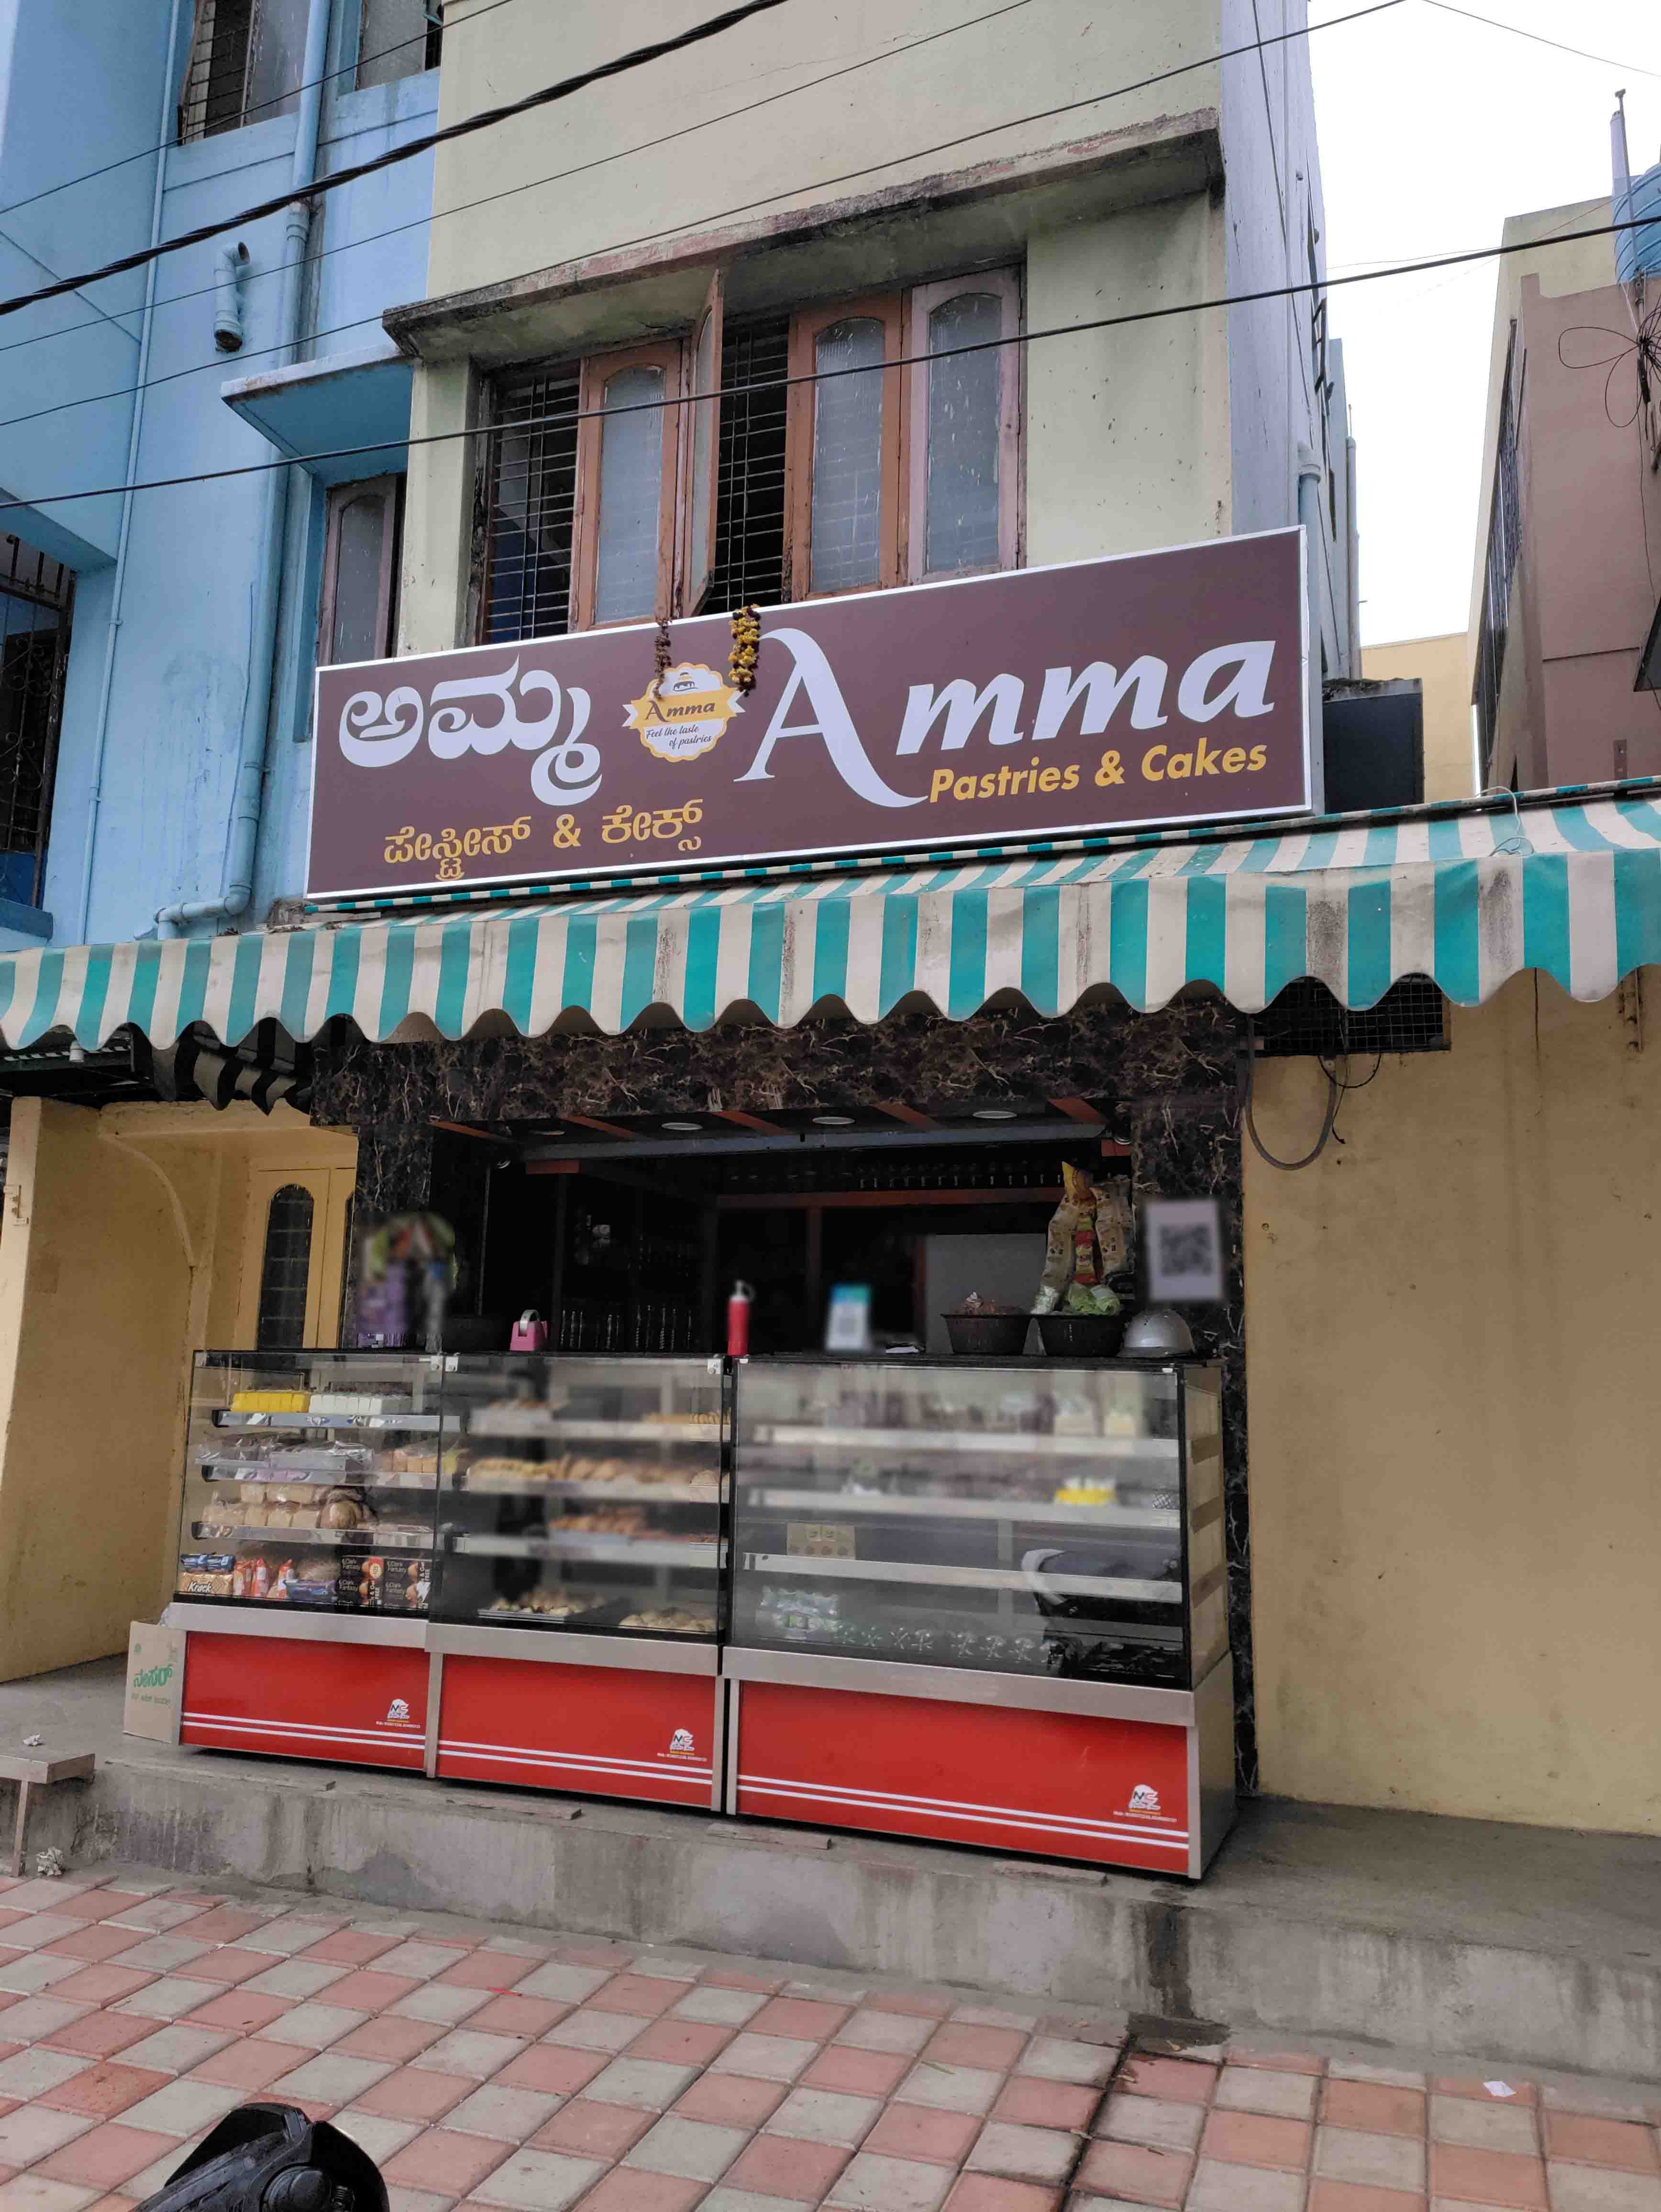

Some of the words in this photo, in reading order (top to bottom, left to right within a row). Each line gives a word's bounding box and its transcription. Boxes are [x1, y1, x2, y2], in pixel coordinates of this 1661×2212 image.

[339, 653, 602, 806] ಅಮ್ಮ
[644, 700, 716, 722] Amma
[647, 727, 663, 739] Feel
[664, 727, 677, 736] the
[679, 724, 699, 735] taste
[669, 738, 678, 750] of
[678, 734, 712, 750] pastries
[733, 628, 1275, 807] Amma
[930, 756, 1079, 803] Pastries
[1095, 750, 1125, 787] &
[1141, 737, 1268, 782] Cakes
[384, 816, 532, 881] ಪೇಸ್ಟ್ರೀಸ್
[553, 814, 582, 848] &
[601, 798, 704, 851] ಕೇಕ್ಸ್
